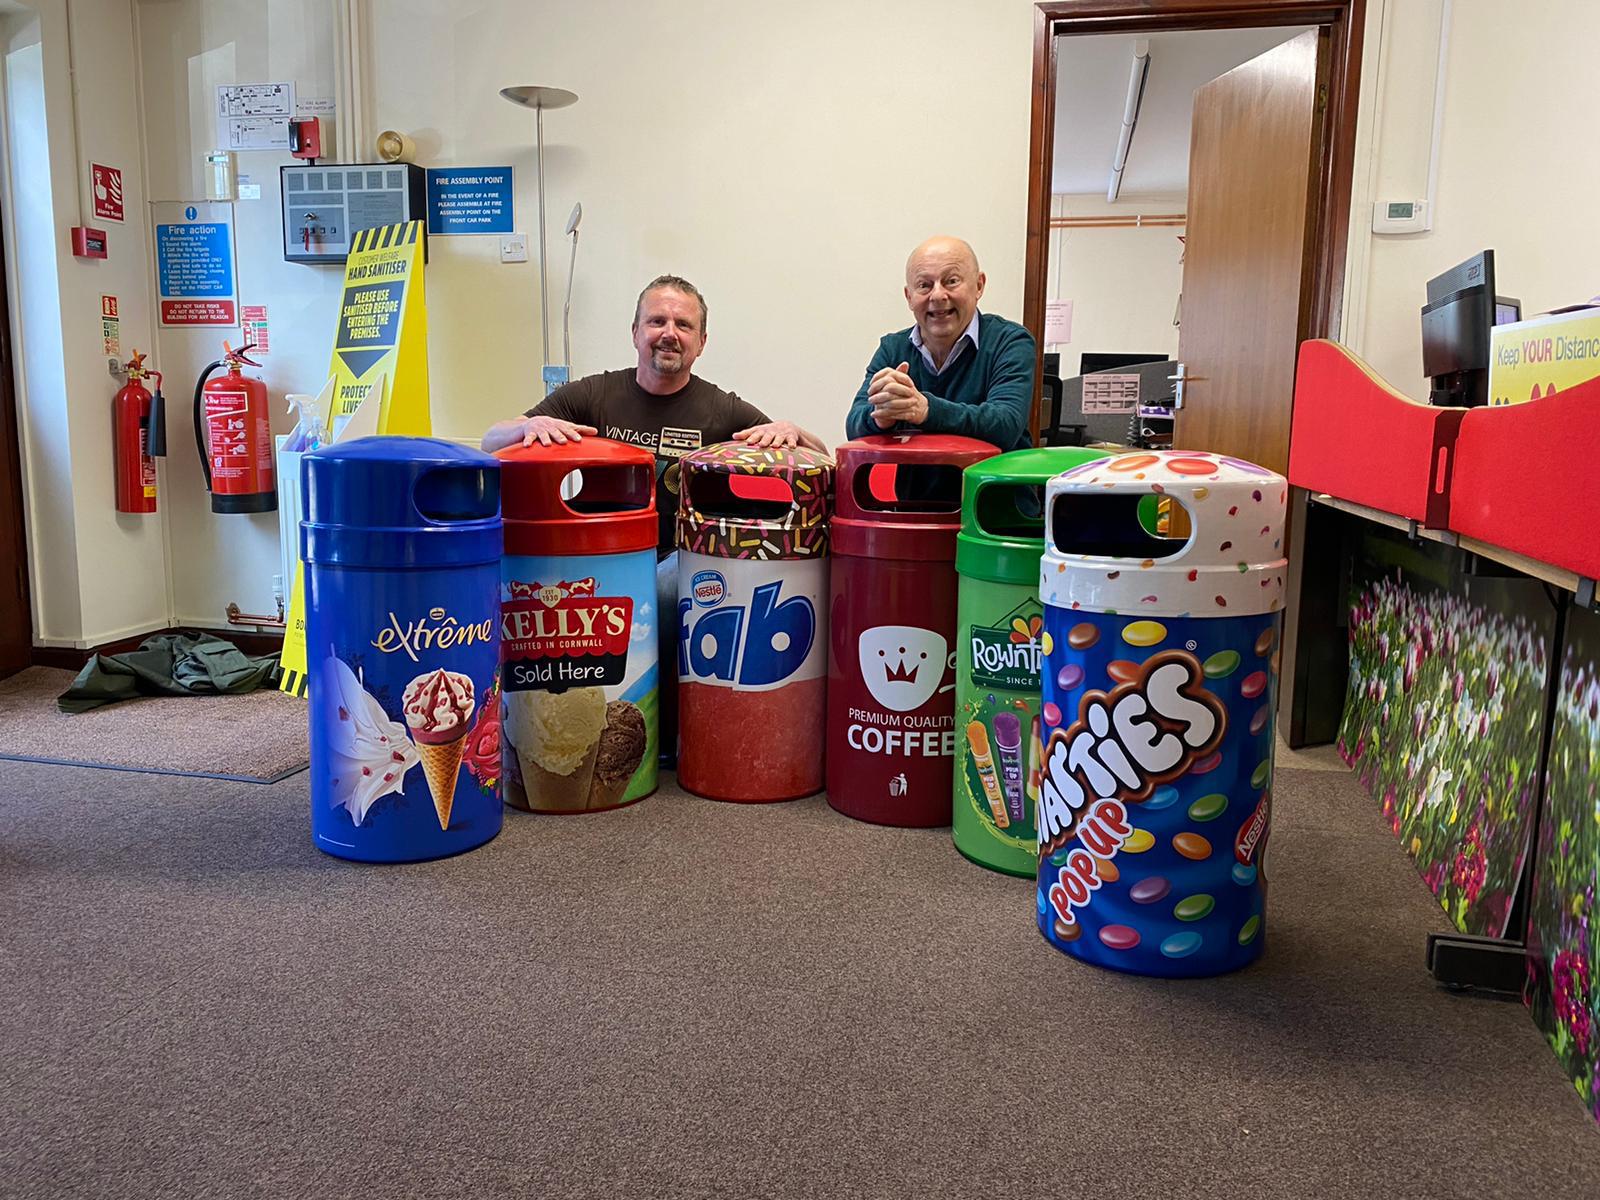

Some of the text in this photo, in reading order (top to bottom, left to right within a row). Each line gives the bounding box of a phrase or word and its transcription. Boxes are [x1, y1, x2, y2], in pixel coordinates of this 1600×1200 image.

[450, 177, 483, 185] ASSEMBLY
[484, 176, 503, 184] POINT
[168, 226, 217, 235] Fire action
[348, 260, 407, 280] HAND SANITISER
[354, 289, 390, 304] PLEASE USE
[343, 300, 399, 317] SANITISER BEFORE
[347, 313, 389, 328] ENTERING THE
[1497, 336, 1600, 370] Keep YOUR Distanc
[605, 425, 660, 446] VINTAGE
[501, 605, 626, 641] KELLY'S
[679, 579, 816, 685] fab
[511, 639, 603, 651] CRAFTED IN CORNWALL
[514, 661, 605, 684] Sold Here
[1006, 677, 1033, 686] SINCE
[848, 707, 956, 728] PREMIUM QUALITY
[847, 724, 956, 757] COFFEE
[1049, 799, 1133, 924] POP UP
